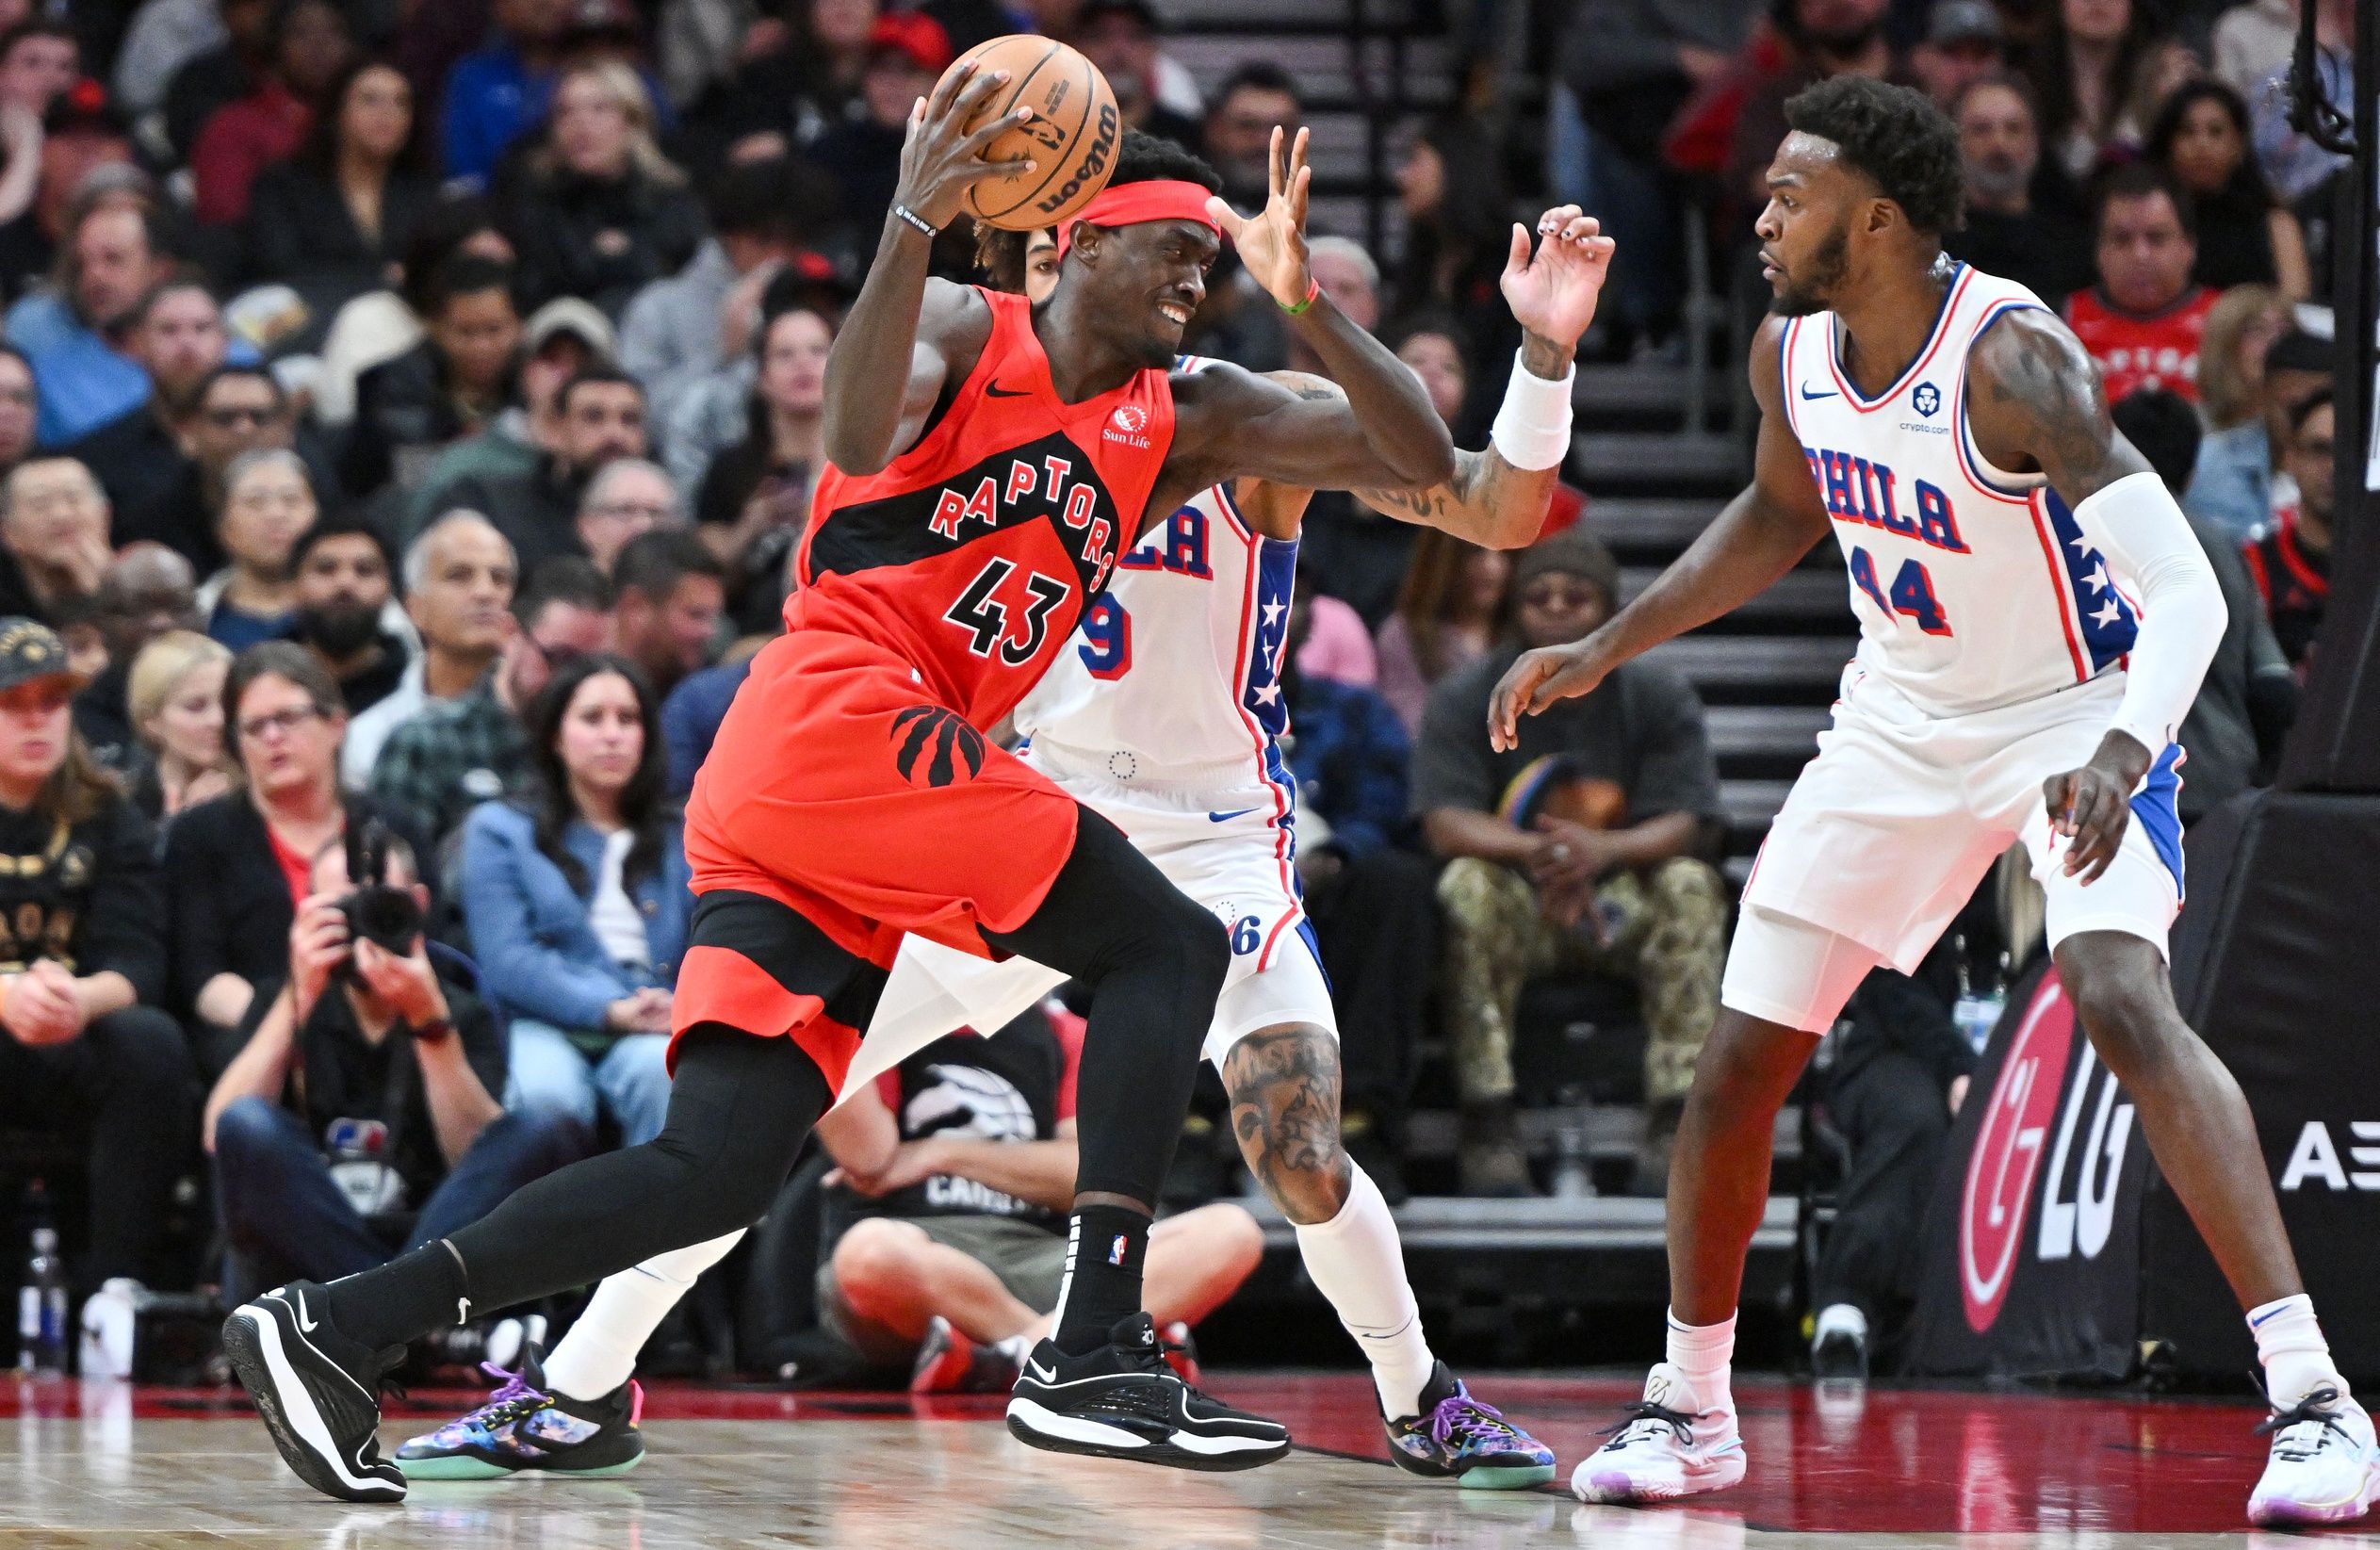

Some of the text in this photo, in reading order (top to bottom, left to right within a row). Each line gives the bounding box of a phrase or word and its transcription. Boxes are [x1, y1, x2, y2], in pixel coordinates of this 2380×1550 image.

[1037, 102, 1117, 213] Wilson
[1102, 428, 1150, 449] Sun Life
[1899, 422, 1949, 434] crypto.com
[928, 455, 1114, 593] RAPTORS
[941, 556, 1071, 667] 43
[1078, 592, 1133, 681] 9
[1850, 545, 1953, 638] 44
[1227, 915, 1261, 956] 6
[2037, 1037, 2135, 1260] LG
